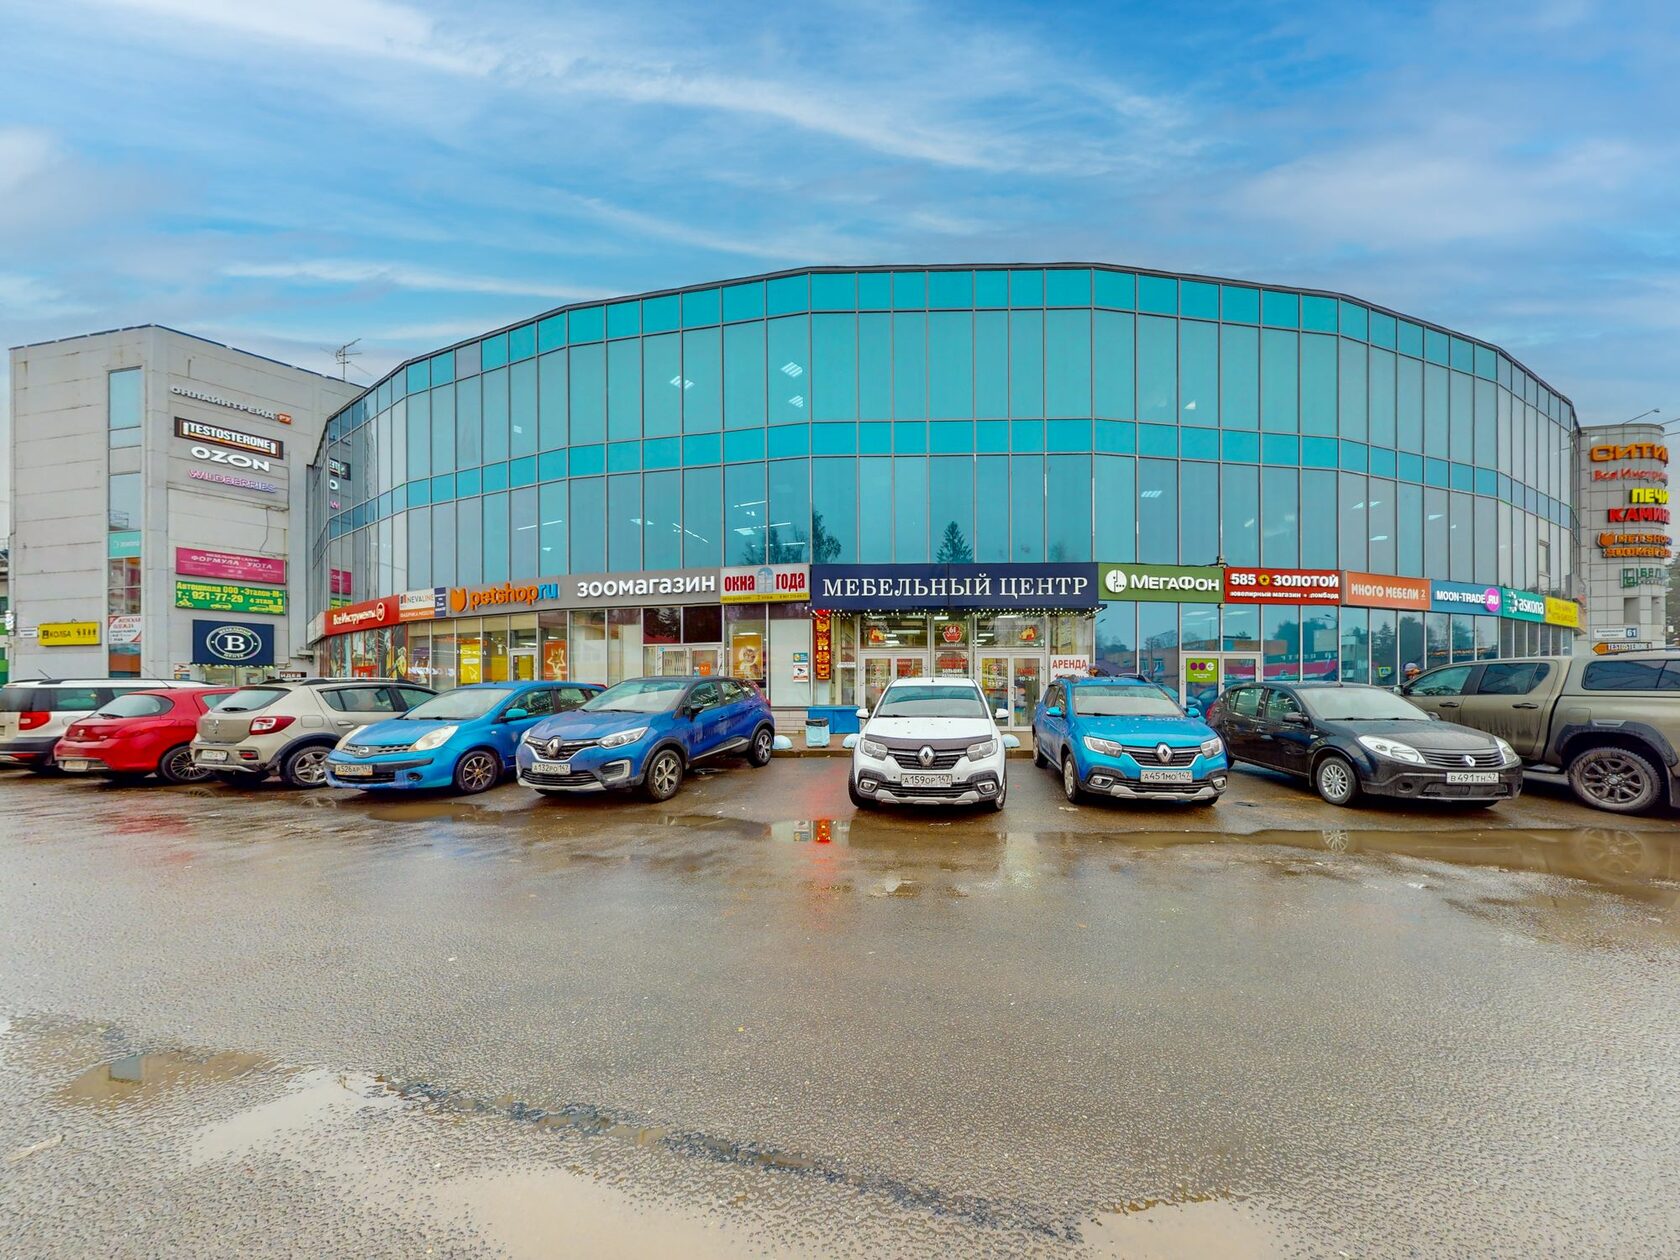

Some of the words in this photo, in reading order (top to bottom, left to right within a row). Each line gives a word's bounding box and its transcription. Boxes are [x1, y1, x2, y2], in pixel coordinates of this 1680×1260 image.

[188, 421, 271, 449] TESTOSTERONE
[191, 446, 270, 472] OZON
[191, 555, 240, 566] ФОРМУЛА
[246, 562, 273, 570] УЮТА
[822, 573, 992, 597] МЕБЕЛЬНЫЙ
[1000, 577, 1089, 599] ЦЕНТР
[1230, 573, 1256, 585] 585
[1272, 574, 1339, 587] ЗОЛОТОЙ
[1351, 583, 1384, 597] МНОГО
[1386, 586, 1419, 600] МЕБЕЛИ
[1518, 597, 1544, 614] askona
[1052, 659, 1087, 669] АРЕНДА
